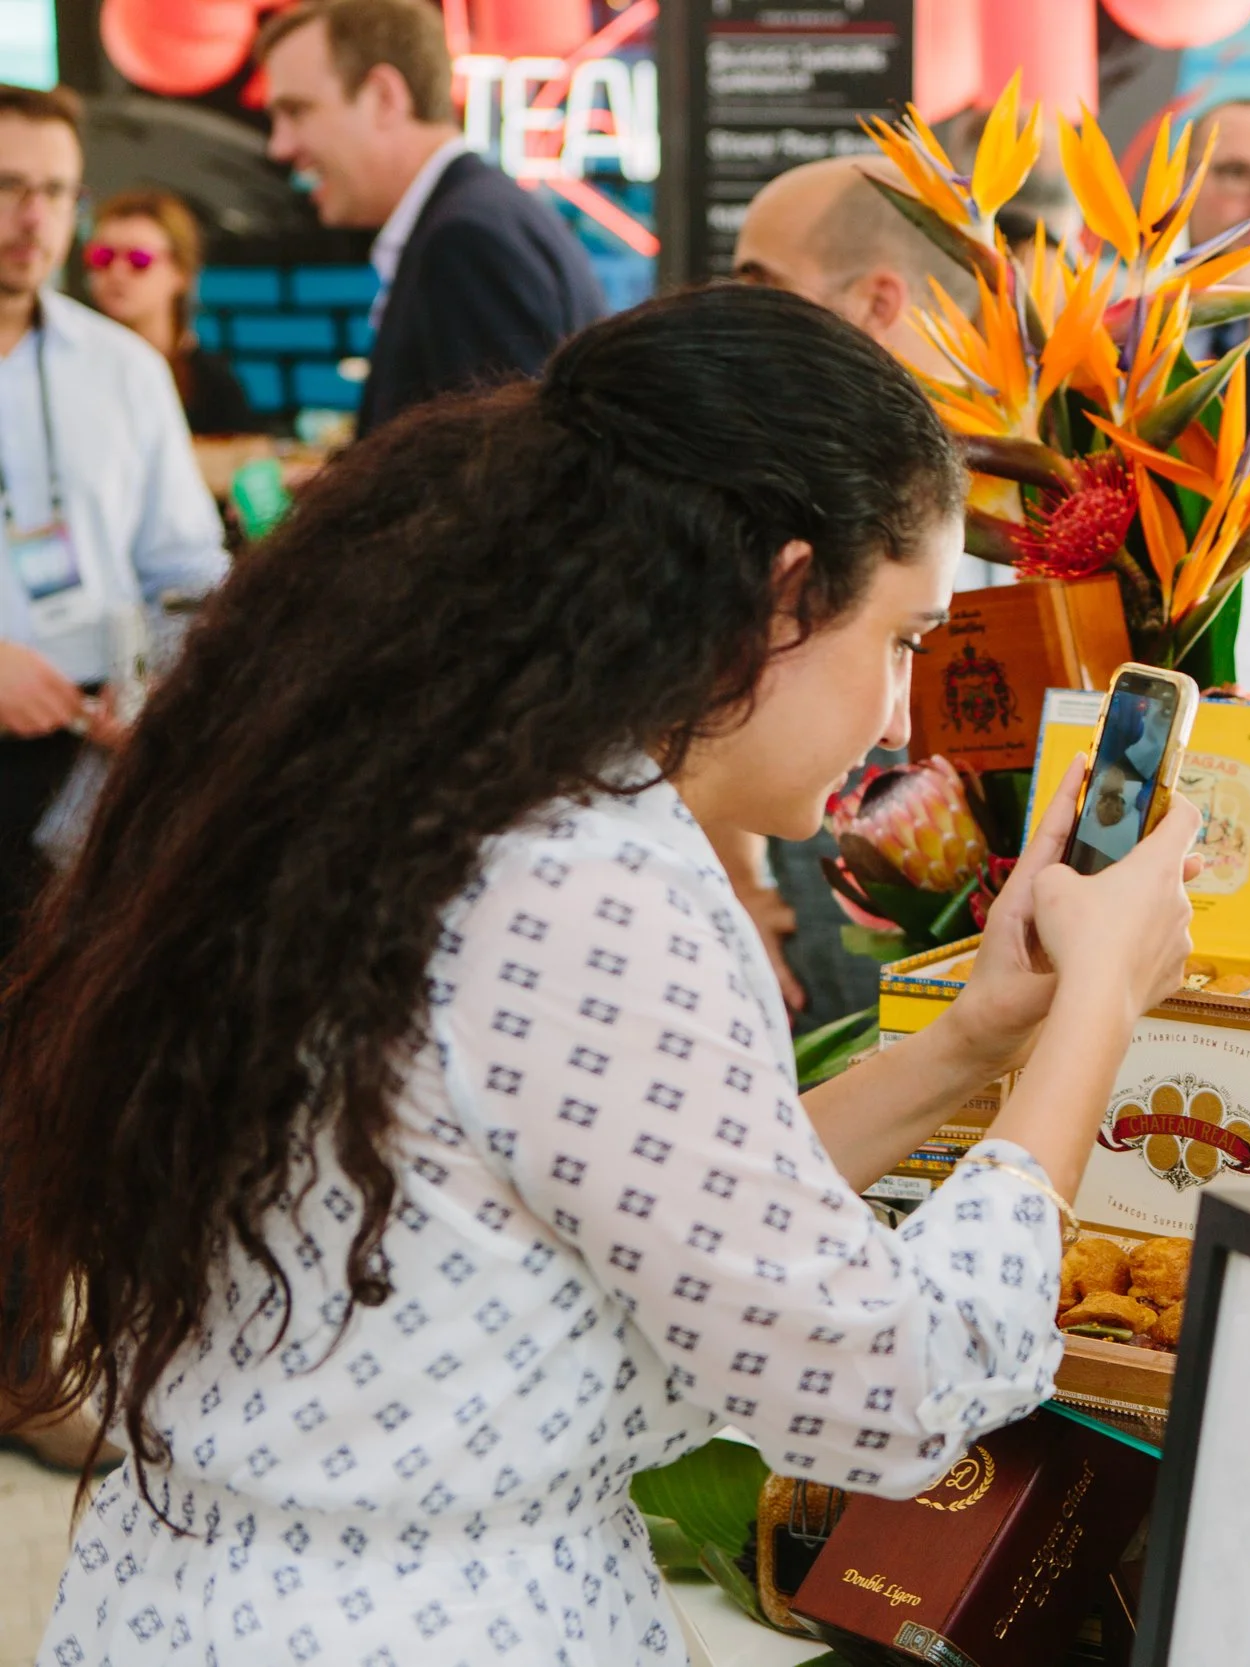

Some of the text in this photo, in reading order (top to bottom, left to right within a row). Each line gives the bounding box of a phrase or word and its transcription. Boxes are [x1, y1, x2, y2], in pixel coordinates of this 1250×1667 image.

[1147, 1032, 1187, 1043] FABRICA
[1193, 1034, 1217, 1047] DREW
[1128, 1114, 1236, 1152] CHATEAU REAL
[1107, 1195, 1194, 1231] TABACOS SUPERIO
[842, 1568, 922, 1607] Double Ligero
